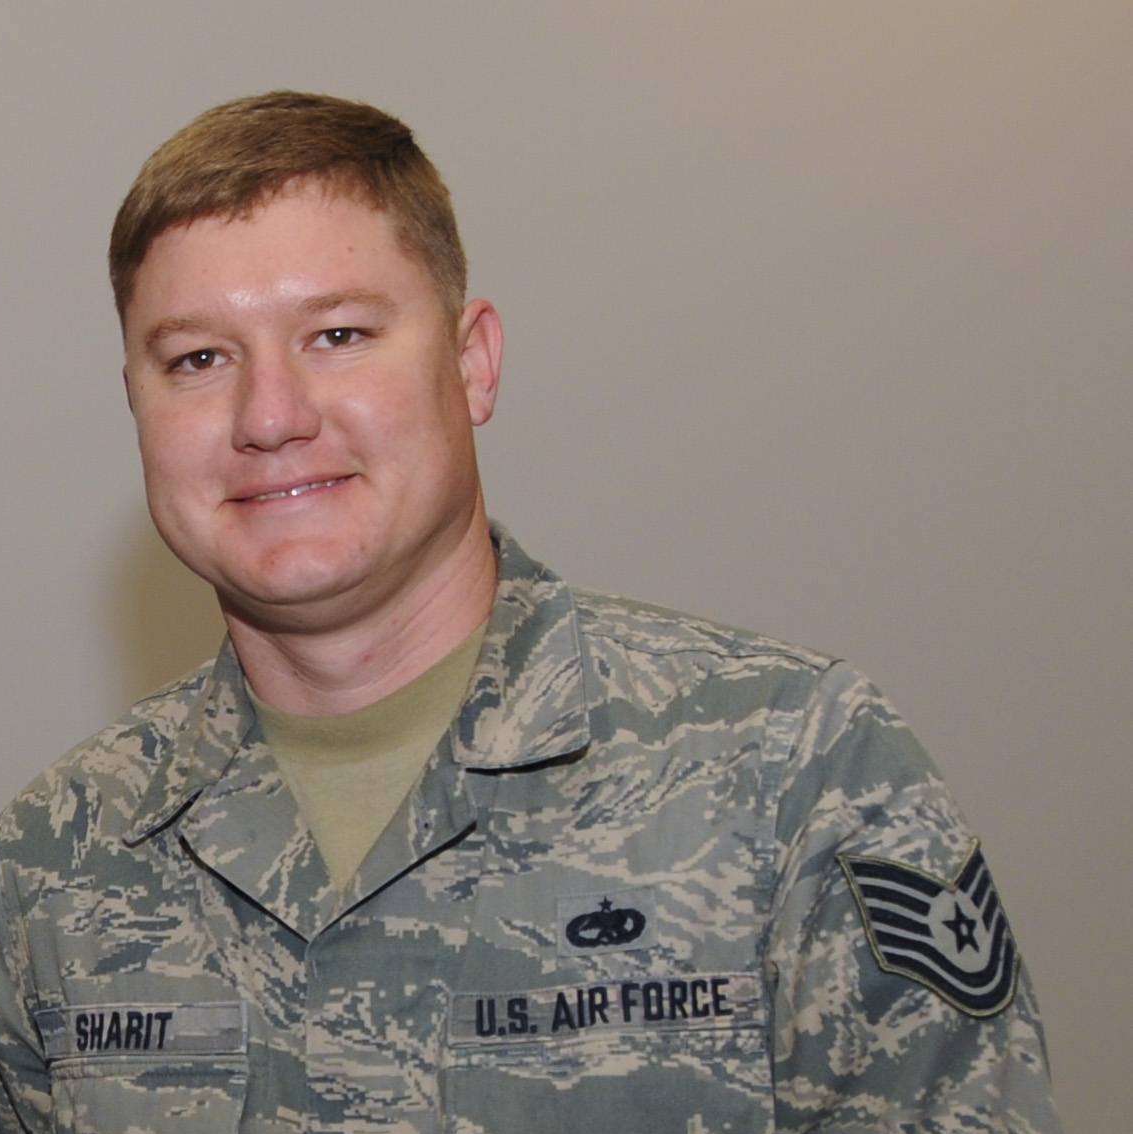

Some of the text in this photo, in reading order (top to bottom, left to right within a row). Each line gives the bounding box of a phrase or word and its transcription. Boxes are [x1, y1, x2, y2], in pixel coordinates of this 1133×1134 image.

[75, 1011, 173, 1052] SHARIT
[475, 977, 733, 1037] U.S. AIR FORCE
